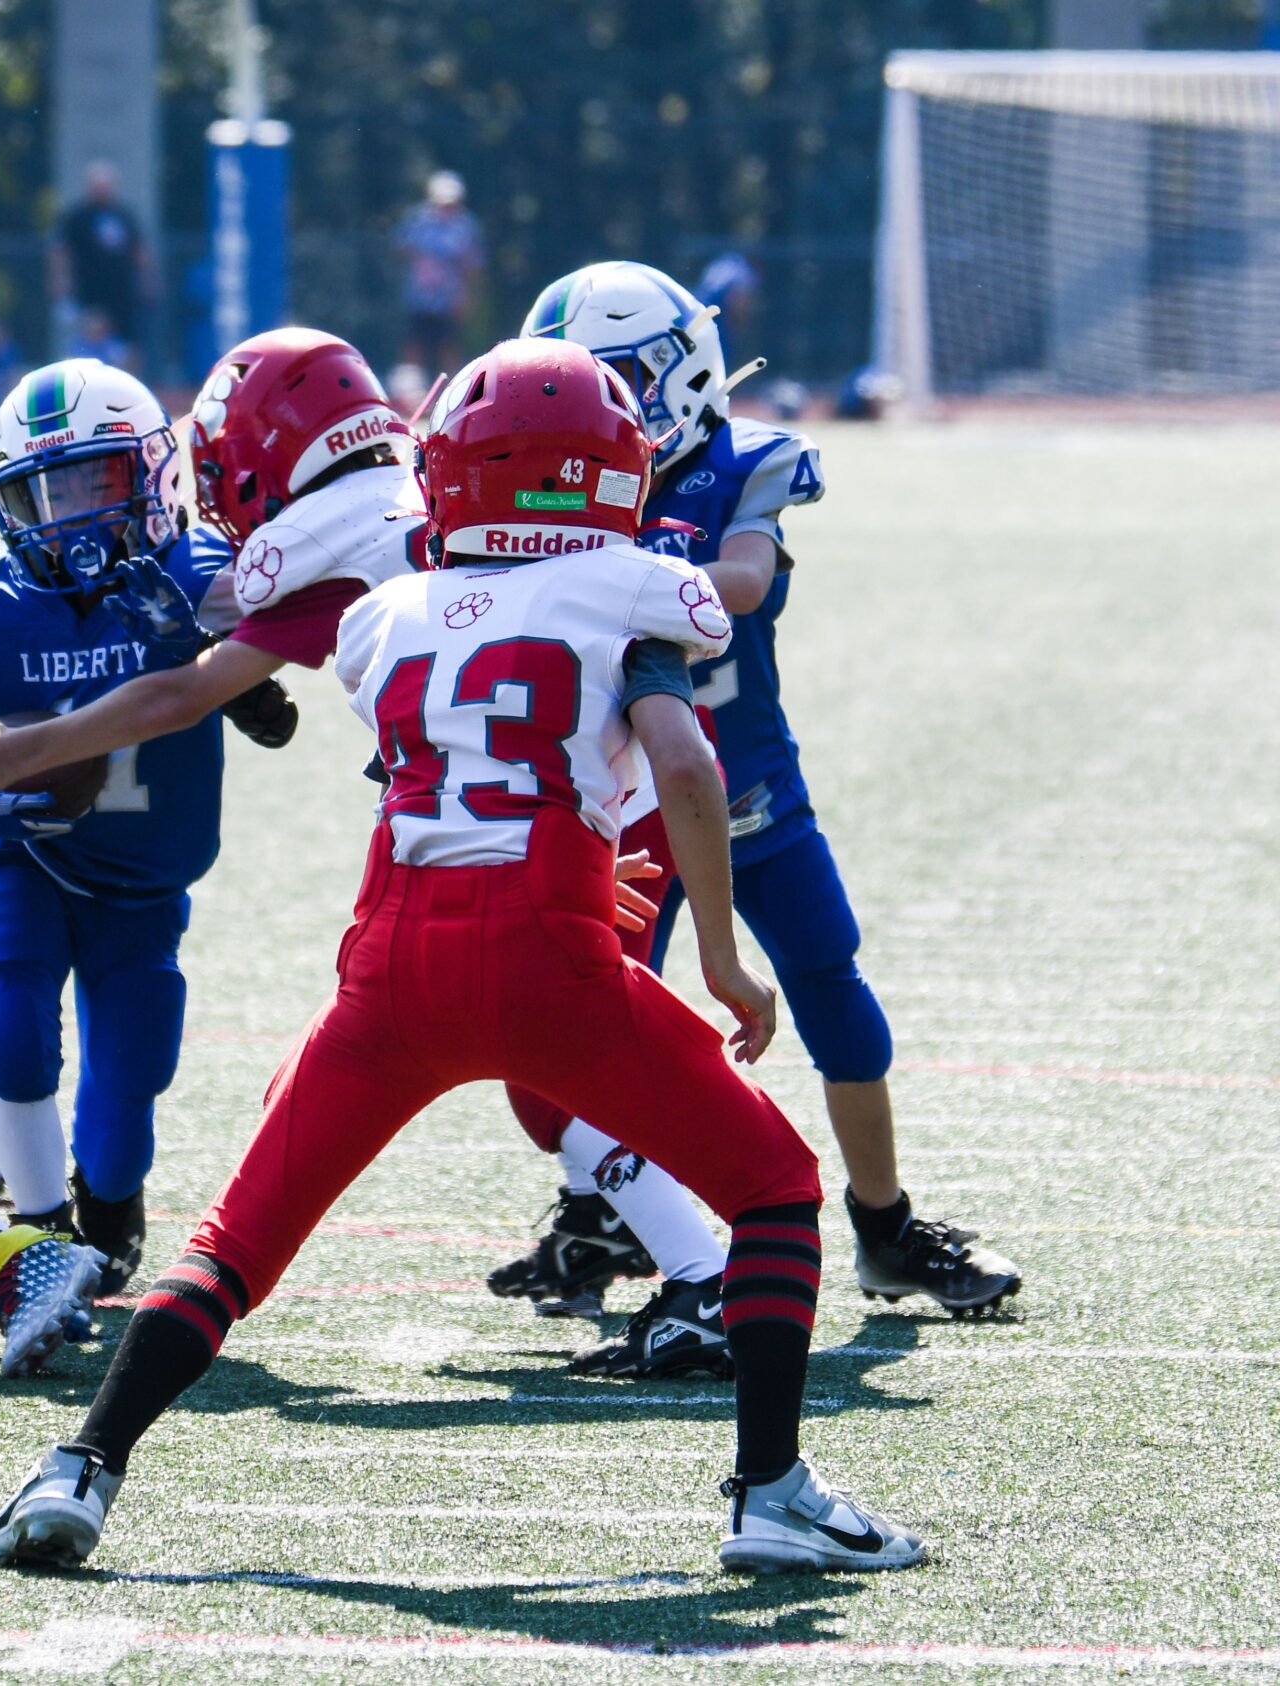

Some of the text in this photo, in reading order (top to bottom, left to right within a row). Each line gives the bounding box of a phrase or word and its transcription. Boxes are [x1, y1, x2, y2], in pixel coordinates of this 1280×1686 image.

[24, 430, 75, 453] Riddell
[560, 458, 585, 484] 43
[485, 529, 606, 555] Riddell
[20, 641, 146, 683] LIBERTY
[374, 635, 582, 822] 43
